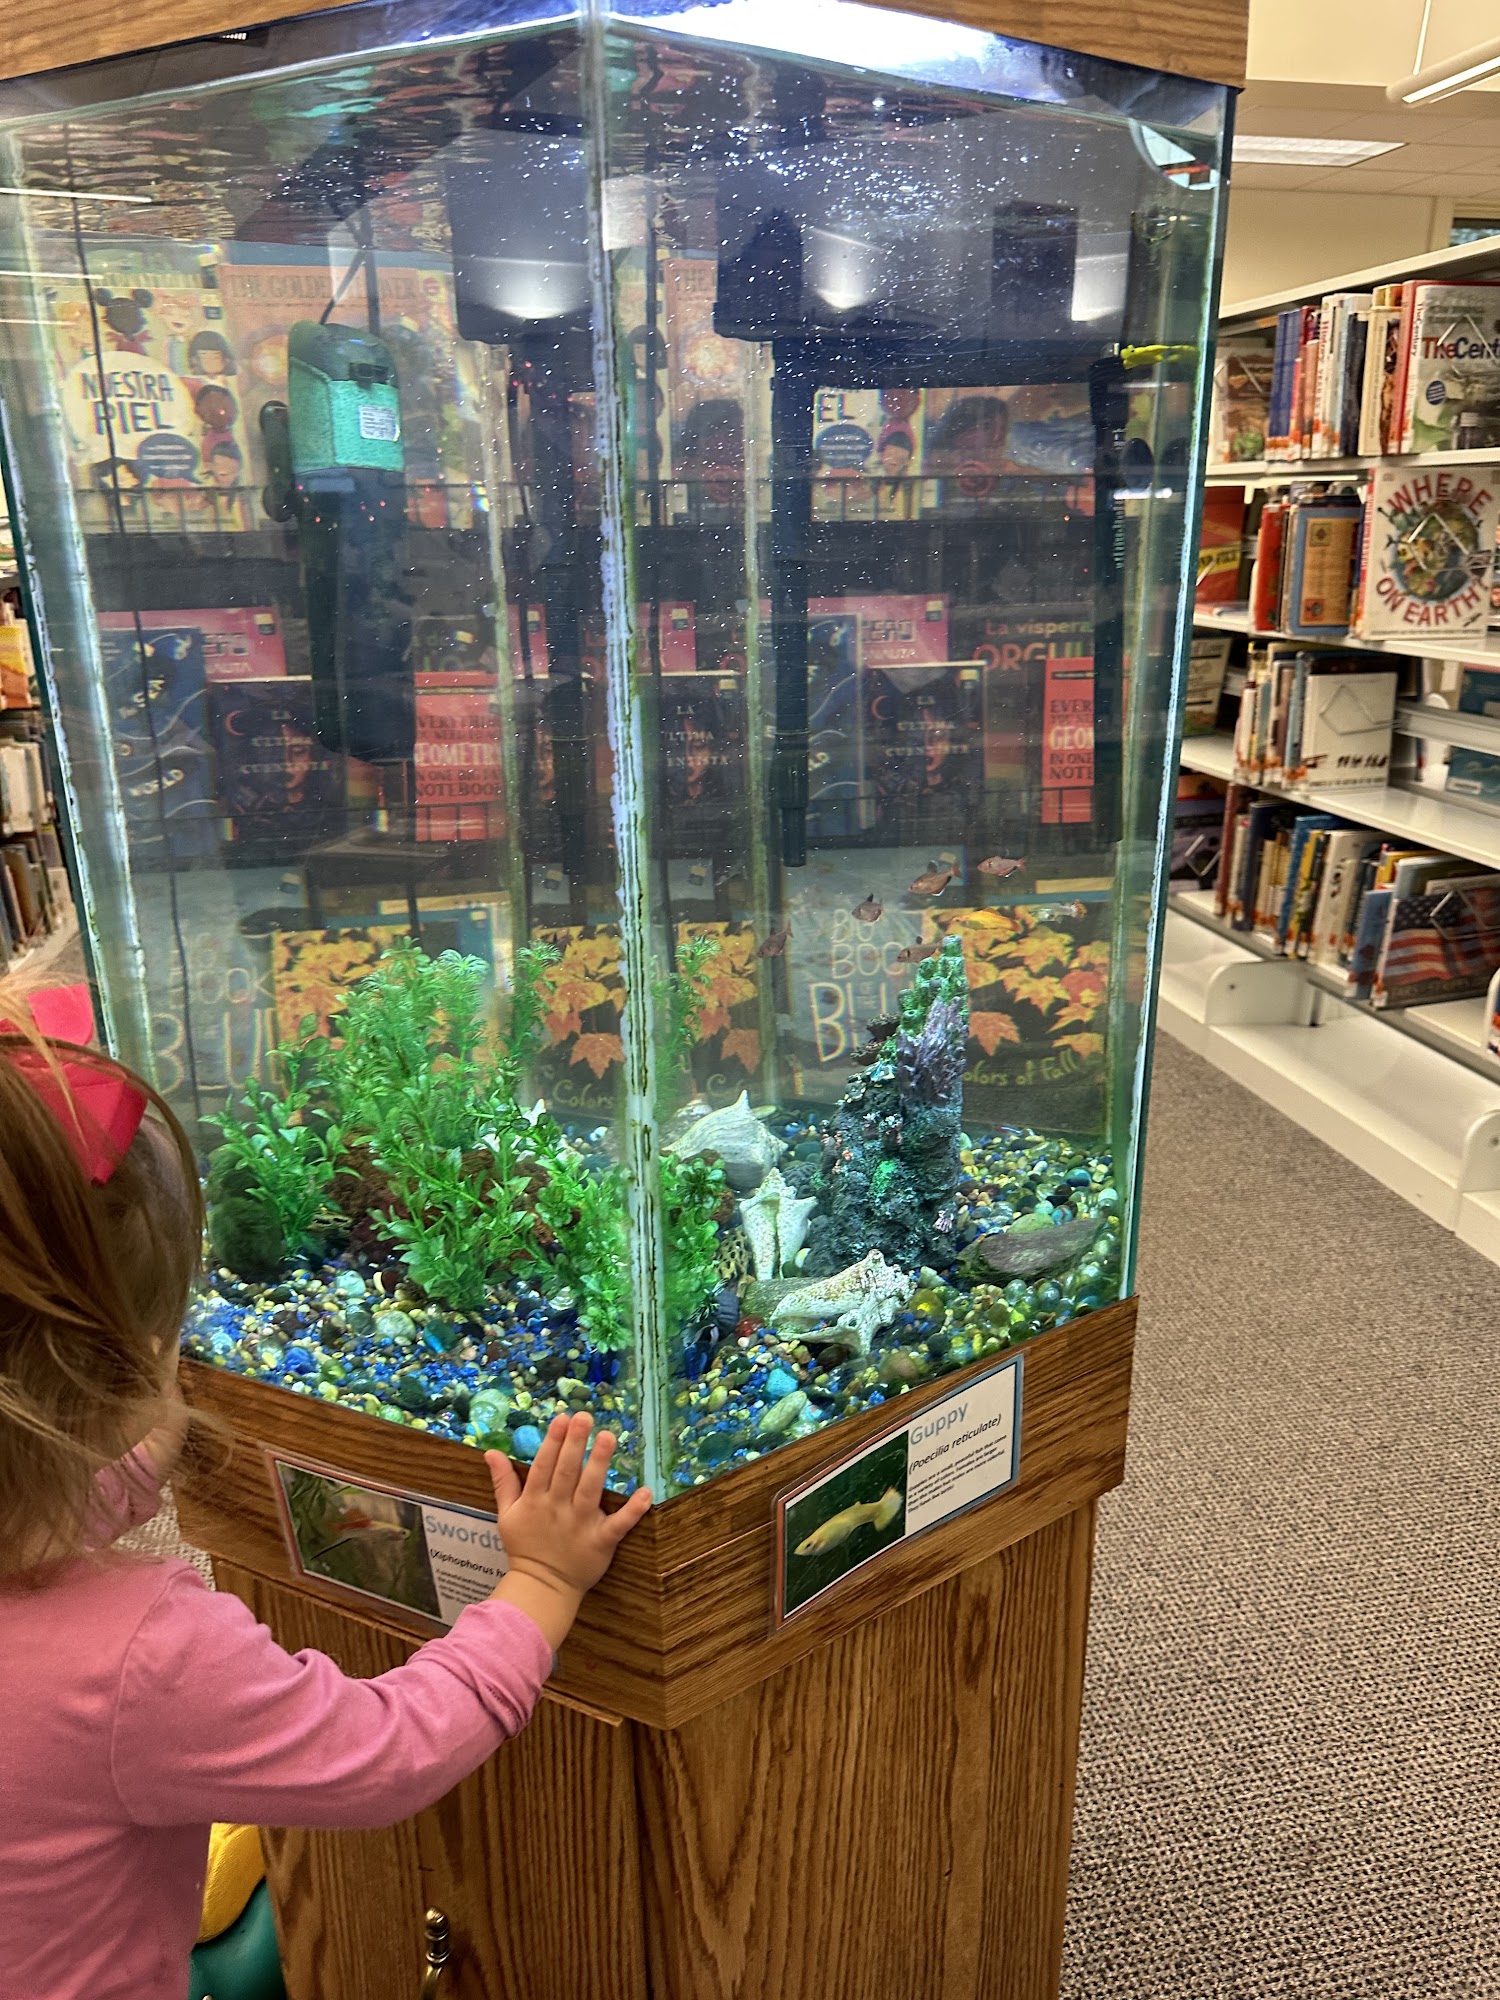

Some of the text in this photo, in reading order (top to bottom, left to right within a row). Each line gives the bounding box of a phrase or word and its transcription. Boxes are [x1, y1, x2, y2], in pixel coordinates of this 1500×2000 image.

[80, 371, 175, 402] NUESTRA
[93, 401, 175, 435] PIEL
[816, 393, 856, 423] EL
[1386, 472, 1494, 517] WHERE
[1376, 577, 1406, 613] ON
[1051, 700, 1094, 713] EVER
[414, 742, 502, 767] EOMETR
[1050, 766, 1094, 780] NOTE
[832, 942, 909, 979] BOO
[963, 1048, 1080, 1086] olors of Fall
[910, 1402, 968, 1446] Guppy
[908, 1413, 1002, 1475] (Poecilia reticulate)
[425, 1514, 505, 1552] Swordt
